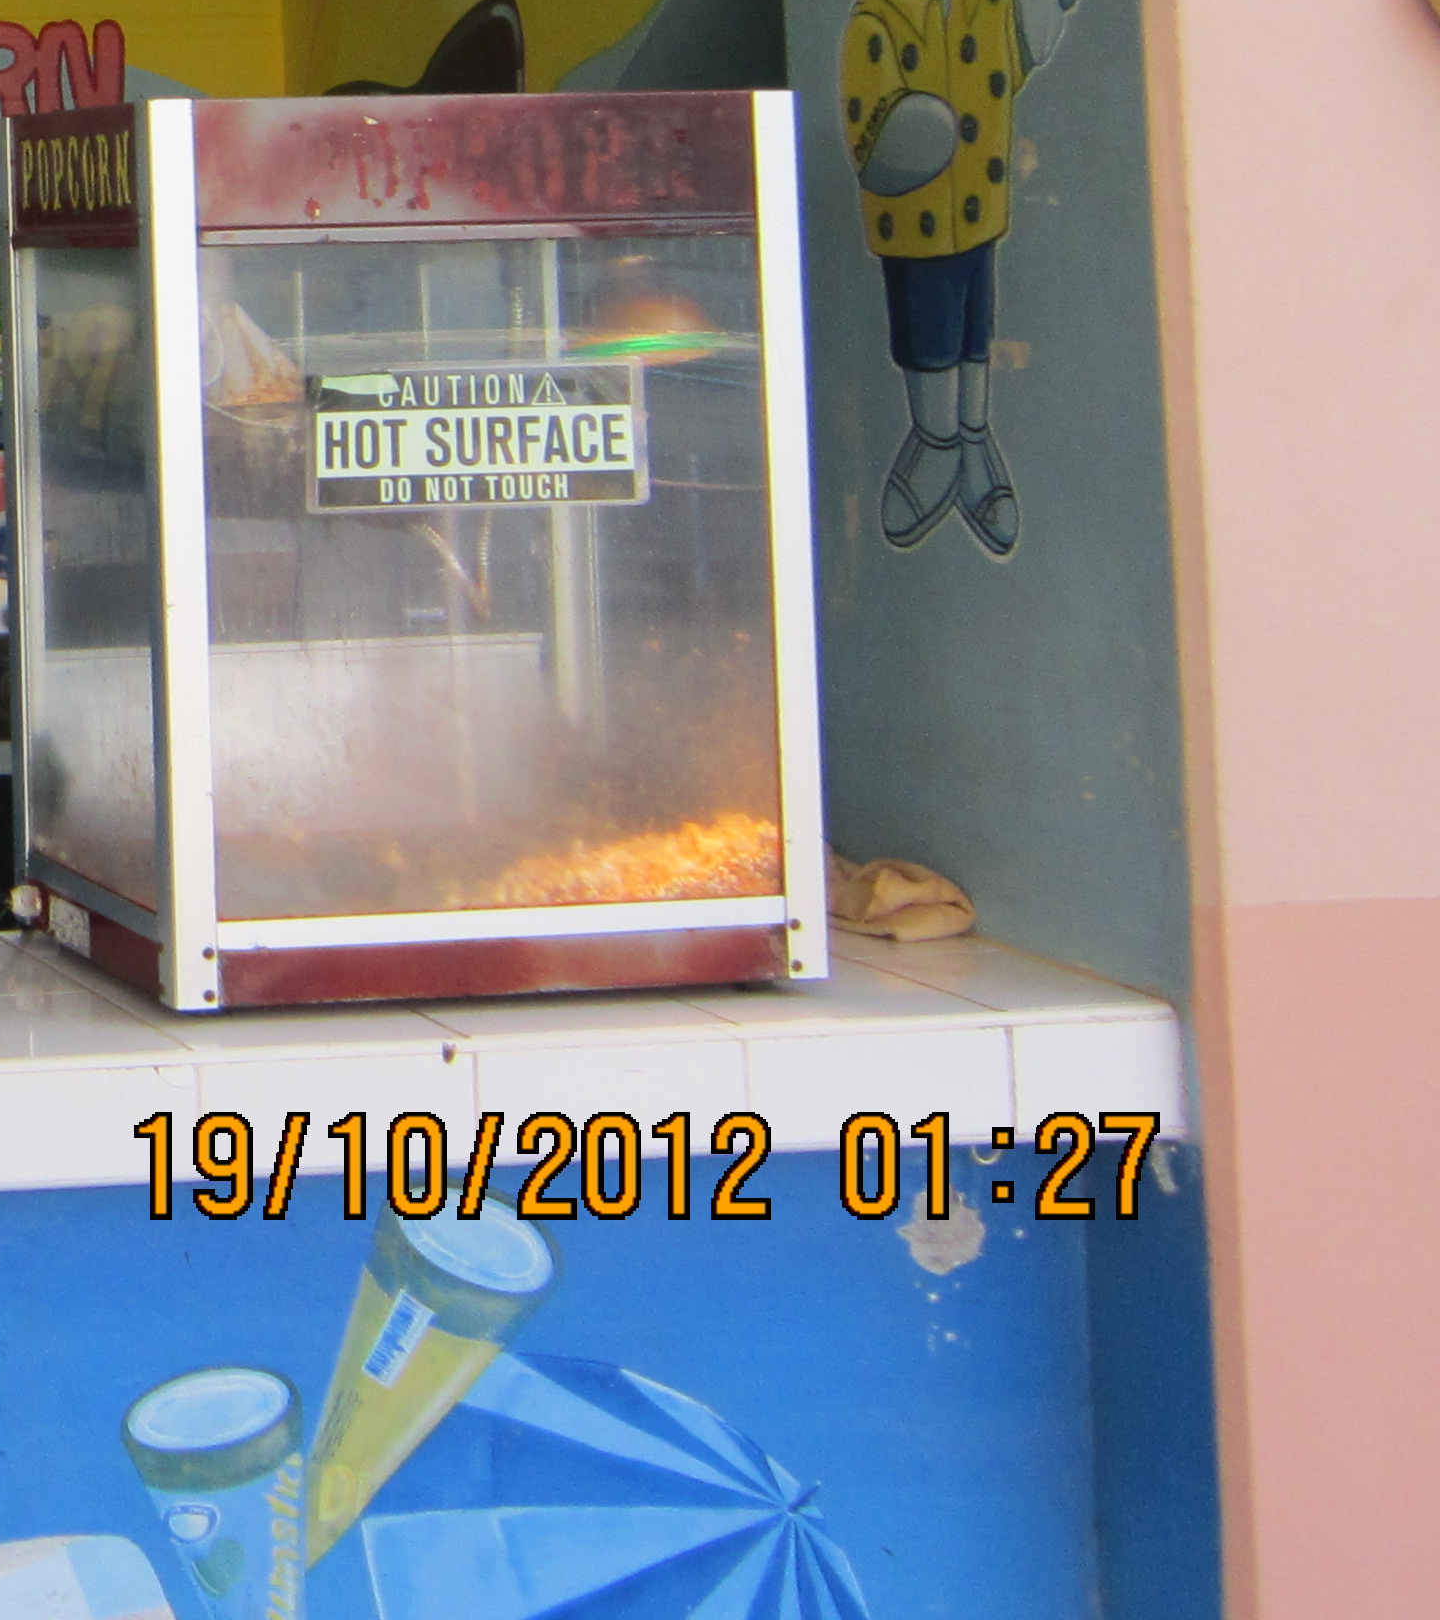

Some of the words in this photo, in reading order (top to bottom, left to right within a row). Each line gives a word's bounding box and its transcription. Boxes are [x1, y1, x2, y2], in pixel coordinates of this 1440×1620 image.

[20, 129, 131, 211] POPCORN
[324, 417, 408, 469] HOT
[425, 412, 628, 467] SURFACE
[380, 477, 412, 503] DO
[425, 476, 473, 501] NOT
[485, 474, 569, 500] TOUCH
